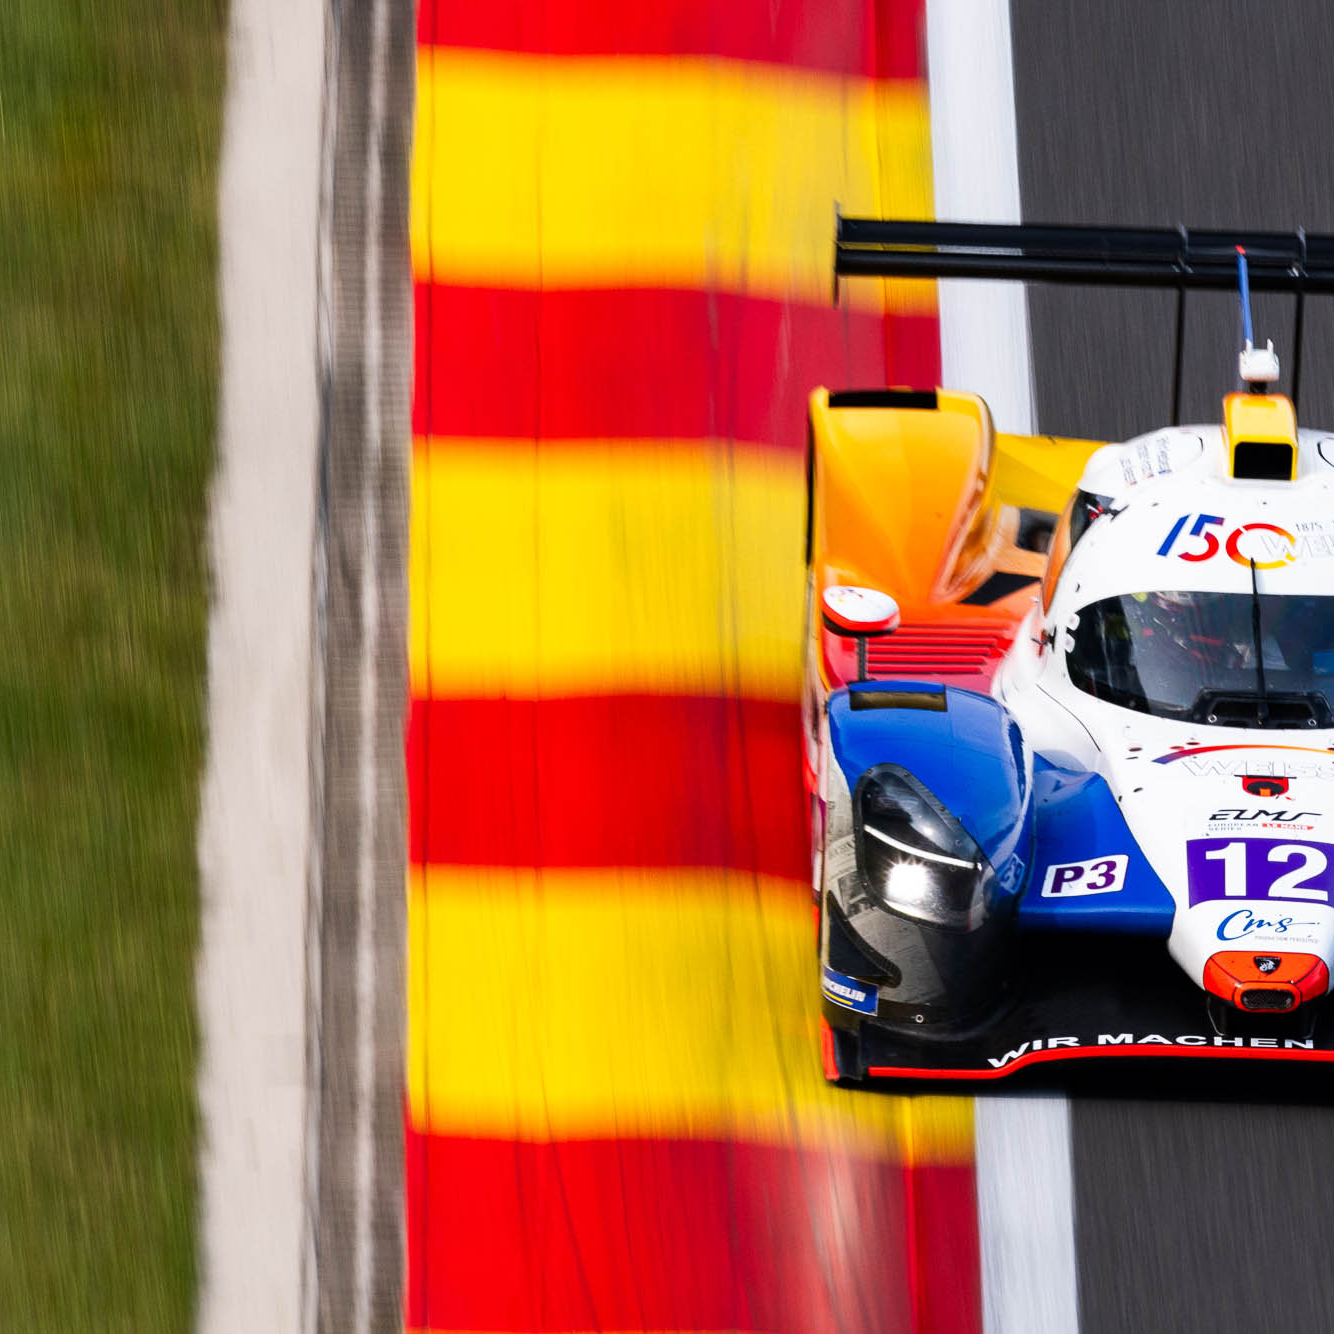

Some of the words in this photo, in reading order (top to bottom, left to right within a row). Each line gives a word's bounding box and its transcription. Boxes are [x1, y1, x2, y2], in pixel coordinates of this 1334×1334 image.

[1050, 860, 1117, 894] P3
[1205, 842, 1329, 902] 12
[987, 1036, 1081, 1069] WIR
[1097, 1033, 1314, 1049] MACHEN
